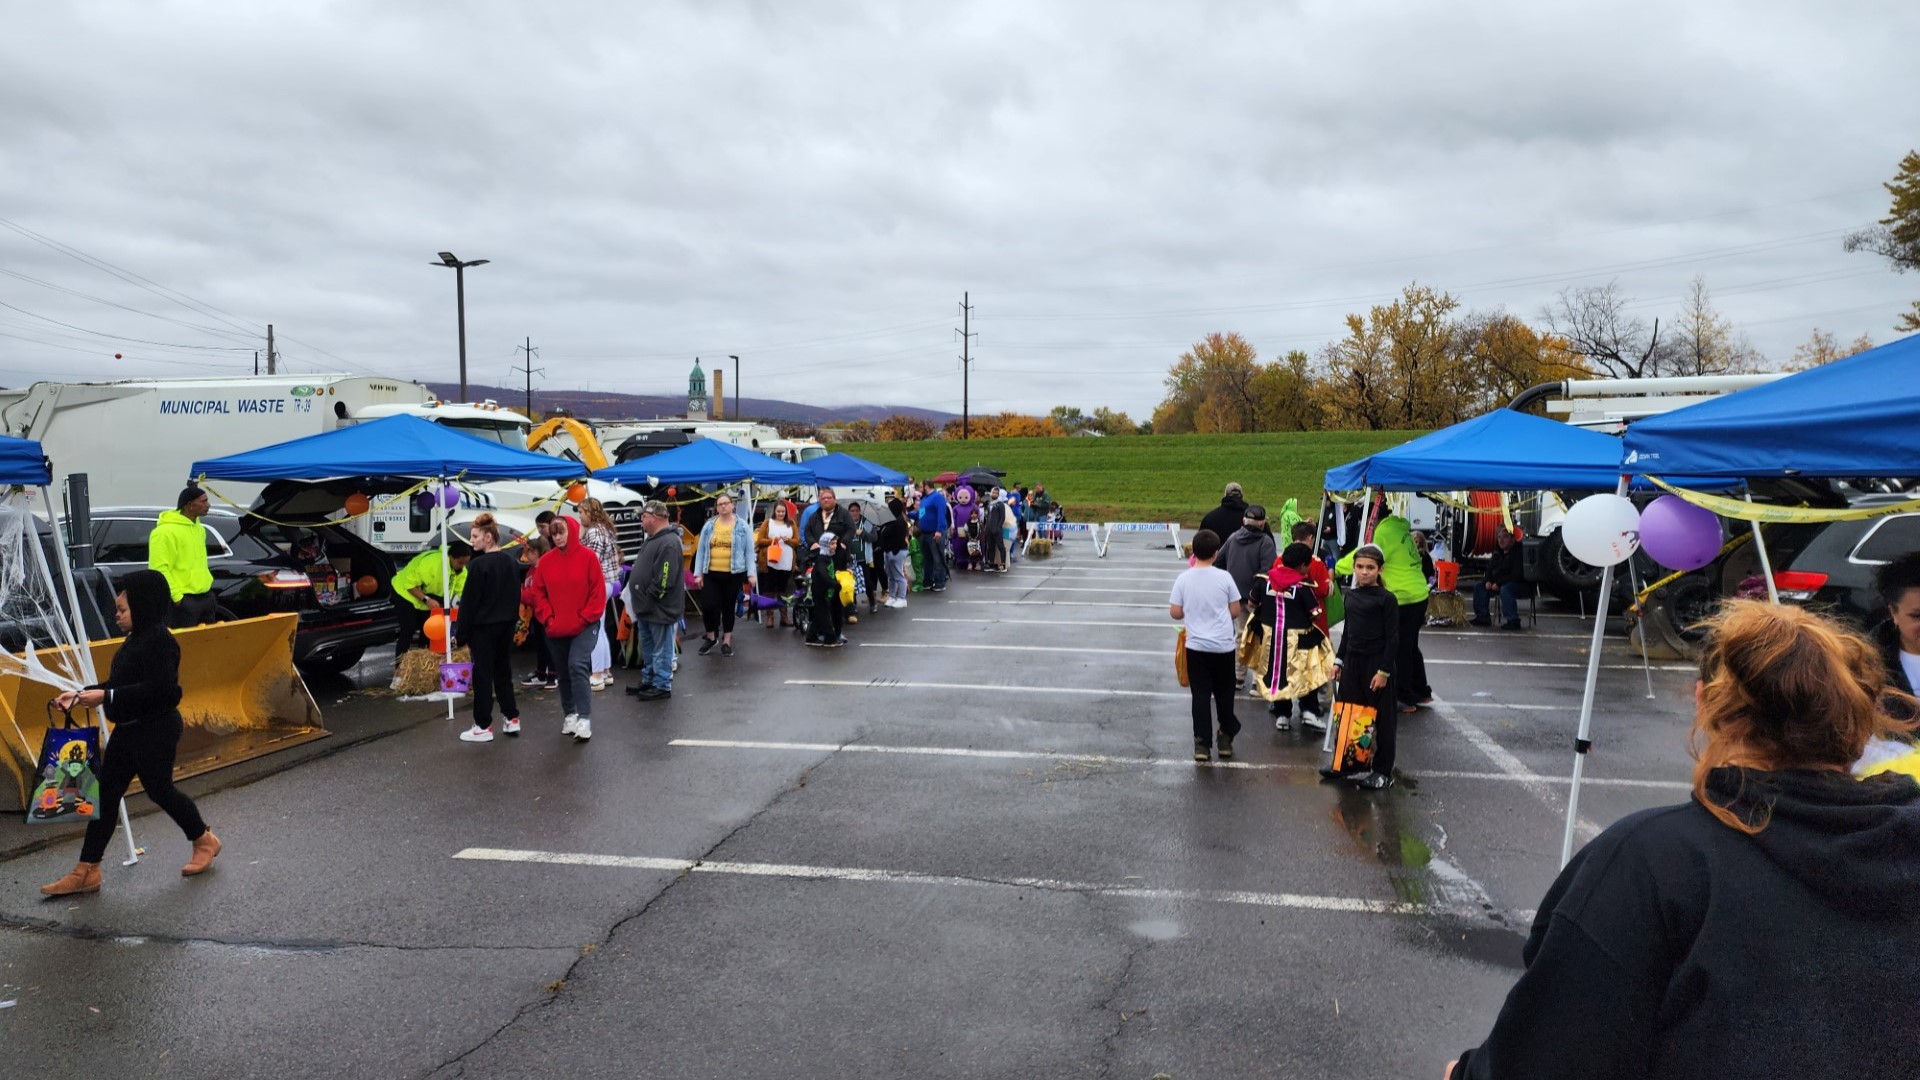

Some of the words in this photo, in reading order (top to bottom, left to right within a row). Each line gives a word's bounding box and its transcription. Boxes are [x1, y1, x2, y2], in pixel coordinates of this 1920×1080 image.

[160, 400, 230, 414] MUNICIPAL
[238, 399, 284, 413] WASTE
[1117, 523, 1130, 531] CITY
